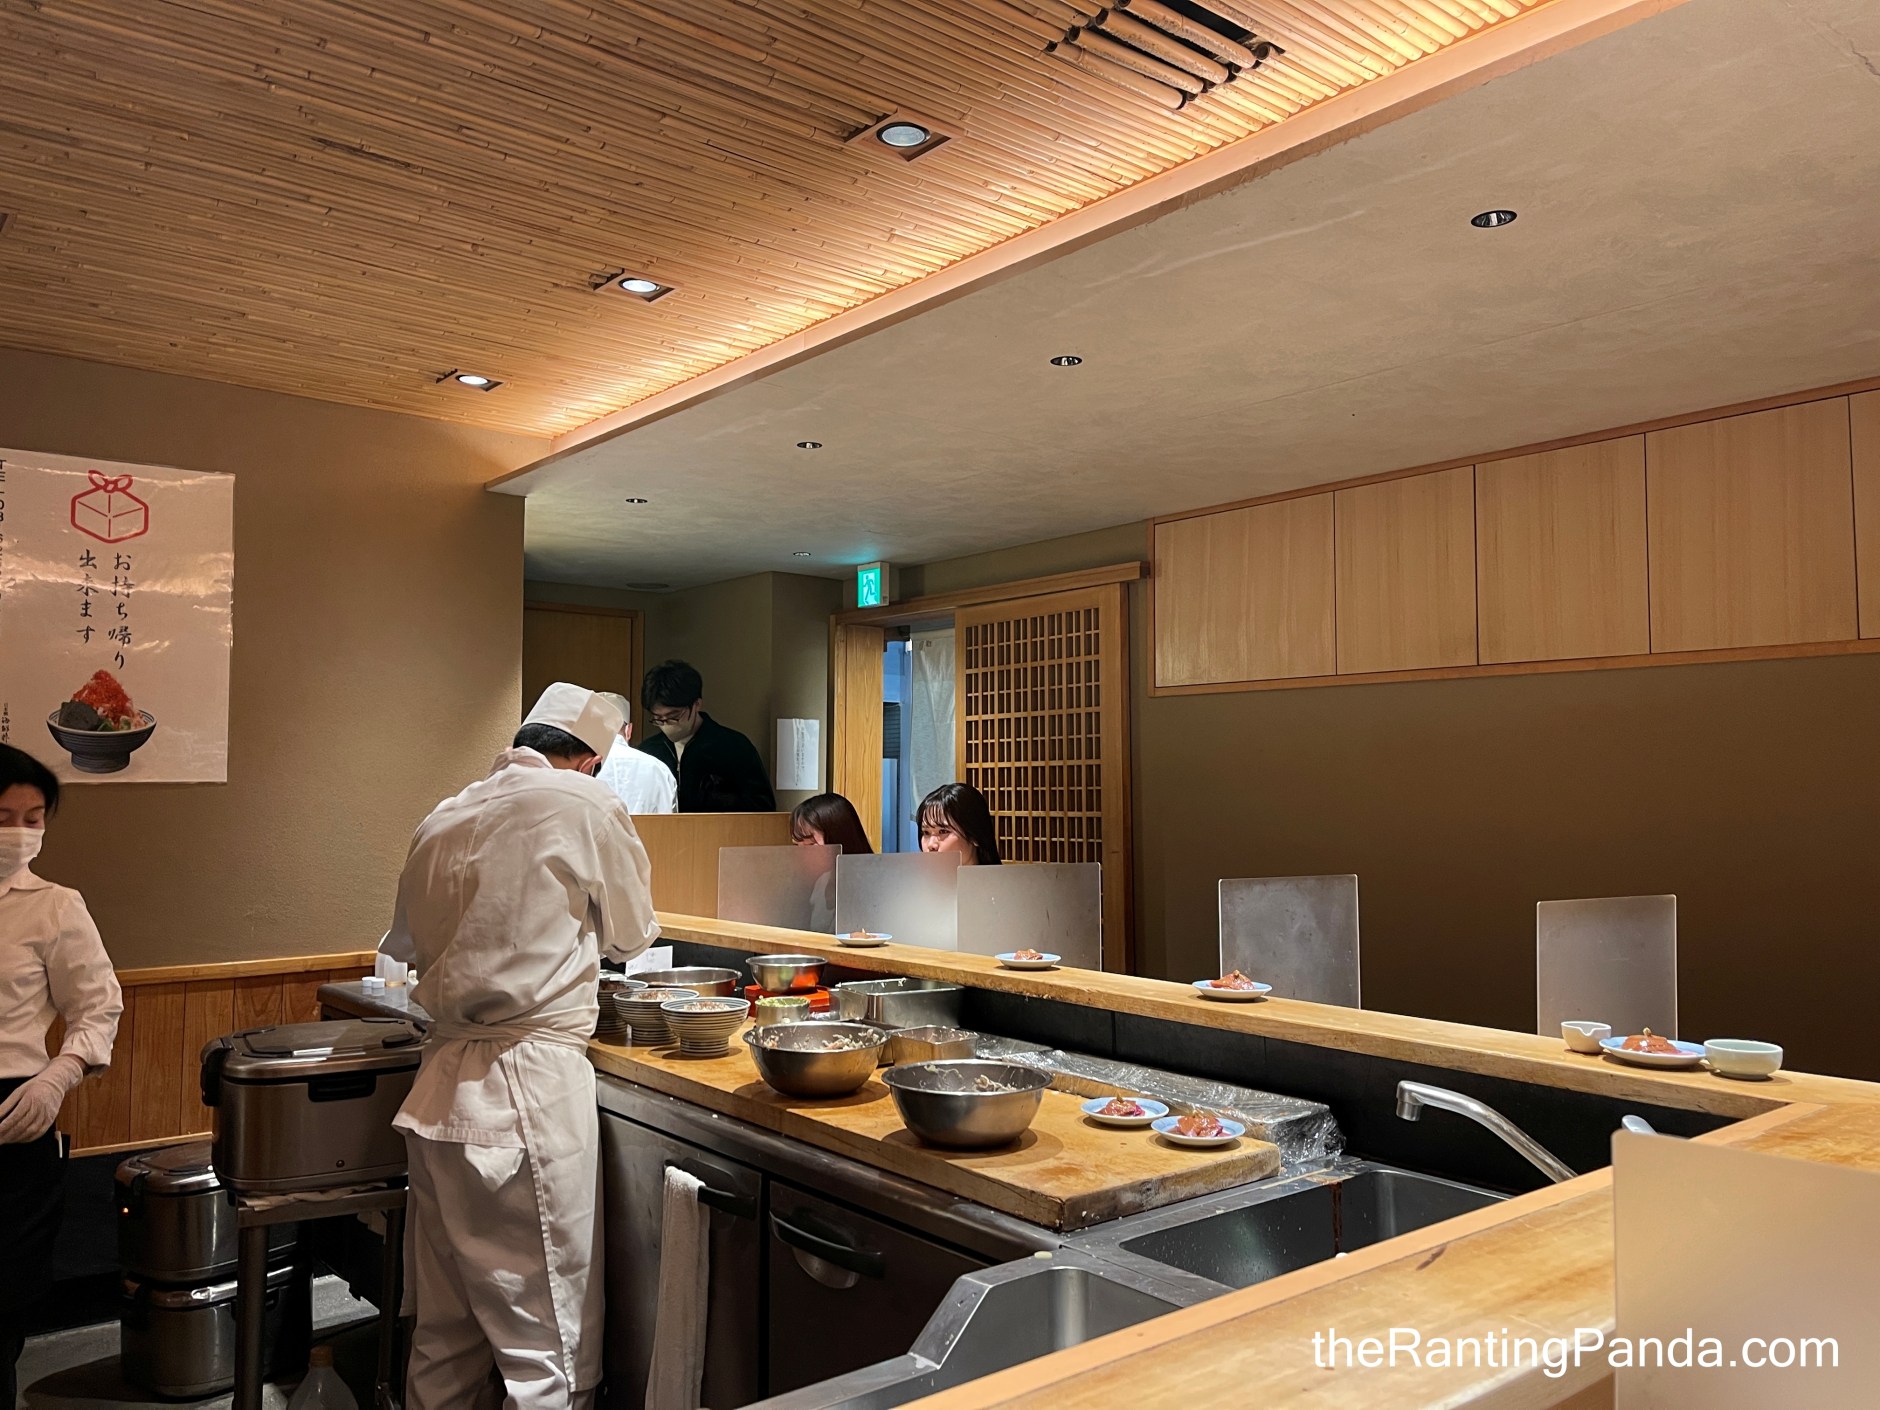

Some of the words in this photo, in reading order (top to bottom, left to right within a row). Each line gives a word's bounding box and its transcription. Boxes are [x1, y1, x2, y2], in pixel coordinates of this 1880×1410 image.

[76, 548, 99, 644] 出来ます
[108, 552, 135, 670] お持ち帰り
